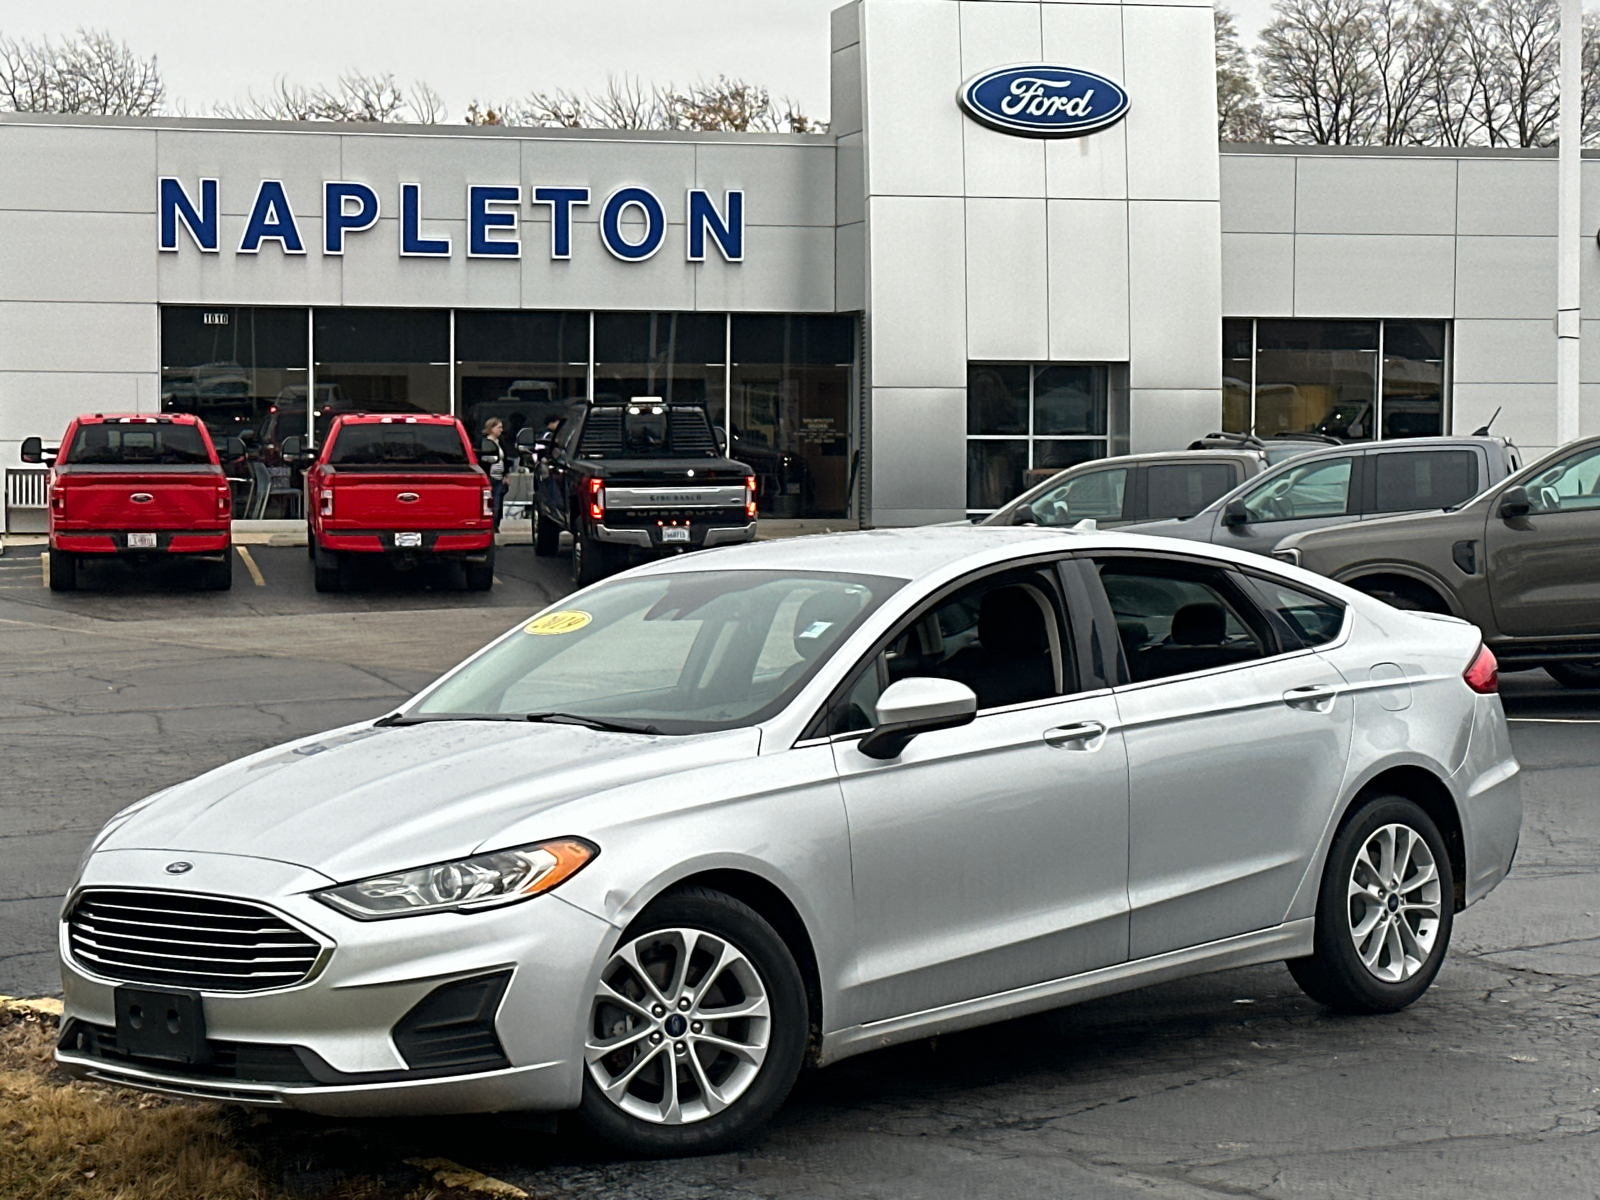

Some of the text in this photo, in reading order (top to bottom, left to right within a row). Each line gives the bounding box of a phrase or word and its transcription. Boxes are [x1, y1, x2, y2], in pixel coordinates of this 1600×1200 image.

[1001, 77, 1095, 117] Ford
[158, 176, 745, 262] NAPLETON
[204, 313, 228, 324] 1010
